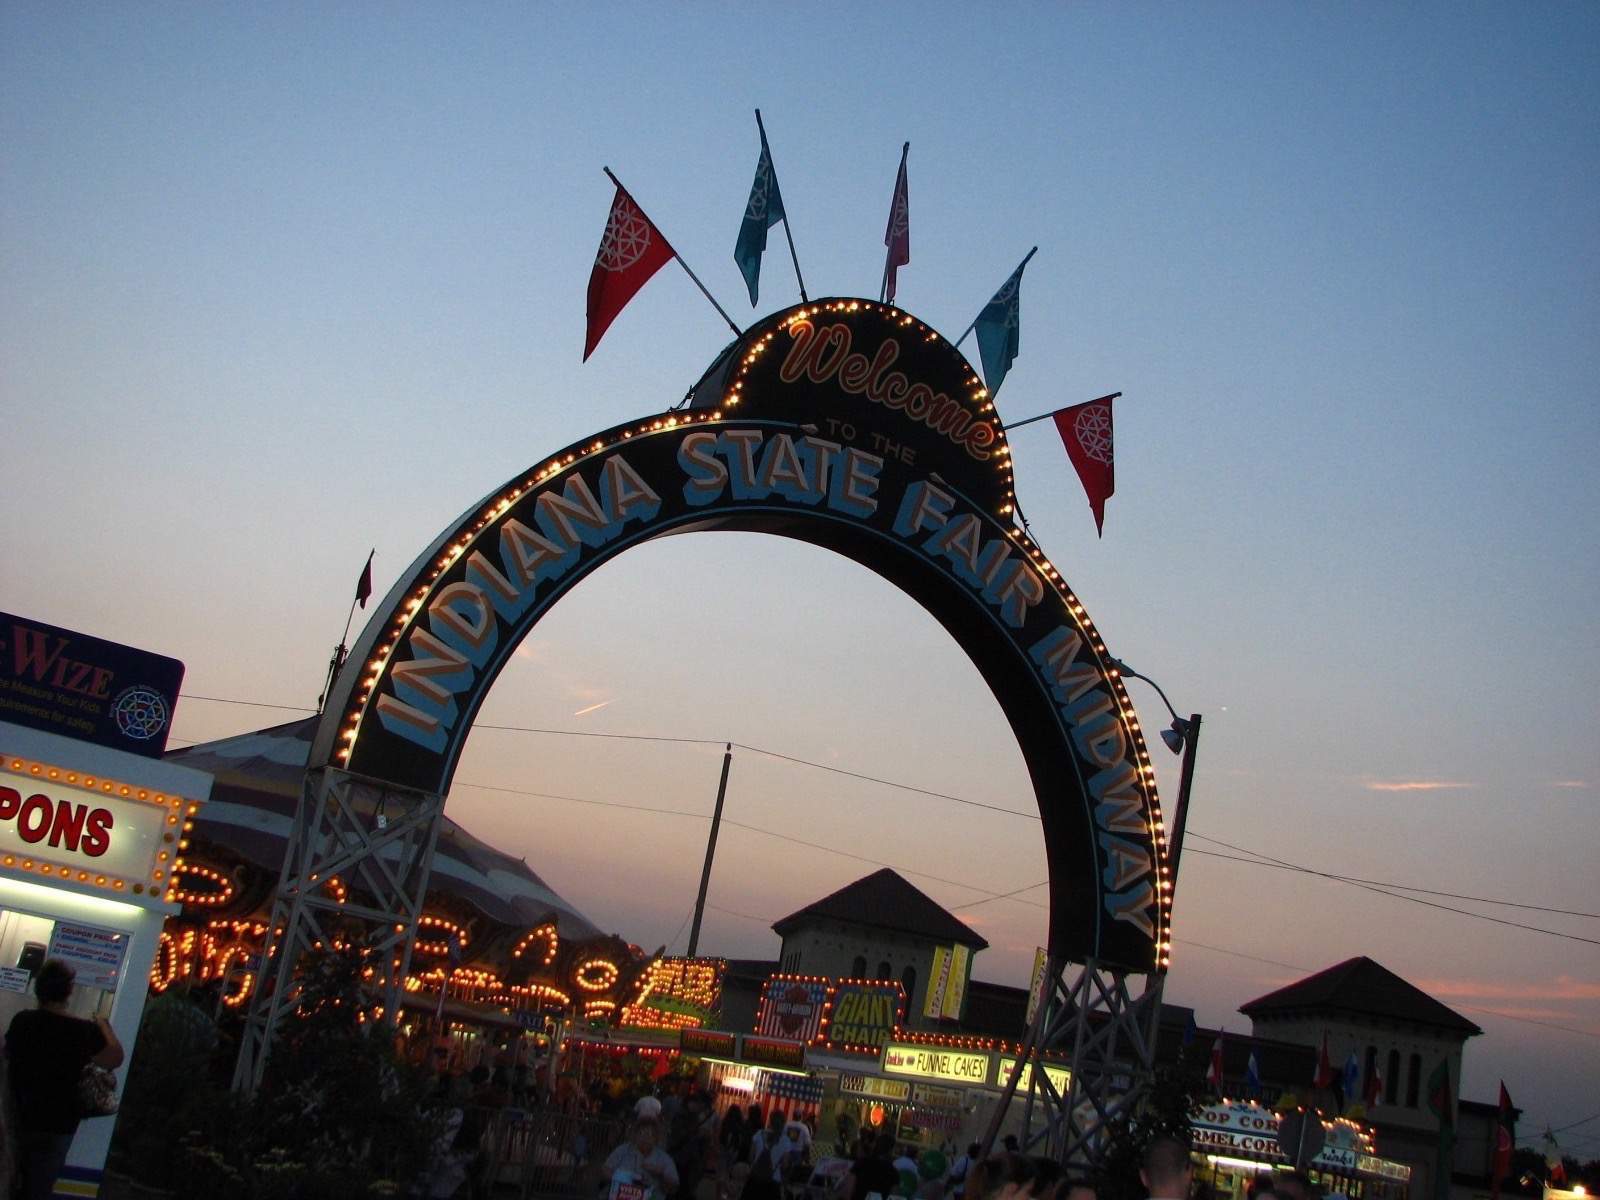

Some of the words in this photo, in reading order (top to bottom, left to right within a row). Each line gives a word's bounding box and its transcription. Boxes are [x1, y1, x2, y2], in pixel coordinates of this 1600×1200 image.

[779, 320, 995, 462] Welcome
[825, 417, 857, 441] TO
[871, 432, 917, 466] THE
[376, 453, 663, 755] INDIANA
[677, 429, 884, 517] STATE
[892, 479, 1044, 628] FAIR
[1027, 625, 1155, 939] MIDWAY
[0, 785, 114, 857] PONS
[834, 988, 894, 1026] GIANT
[916, 1052, 951, 1074] FUNNEL
[953, 1056, 985, 1079] CAKES
[1194, 1109, 1230, 1127] OP
[1239, 1114, 1280, 1132] COR
[1321, 1149, 1353, 1165] rinks
